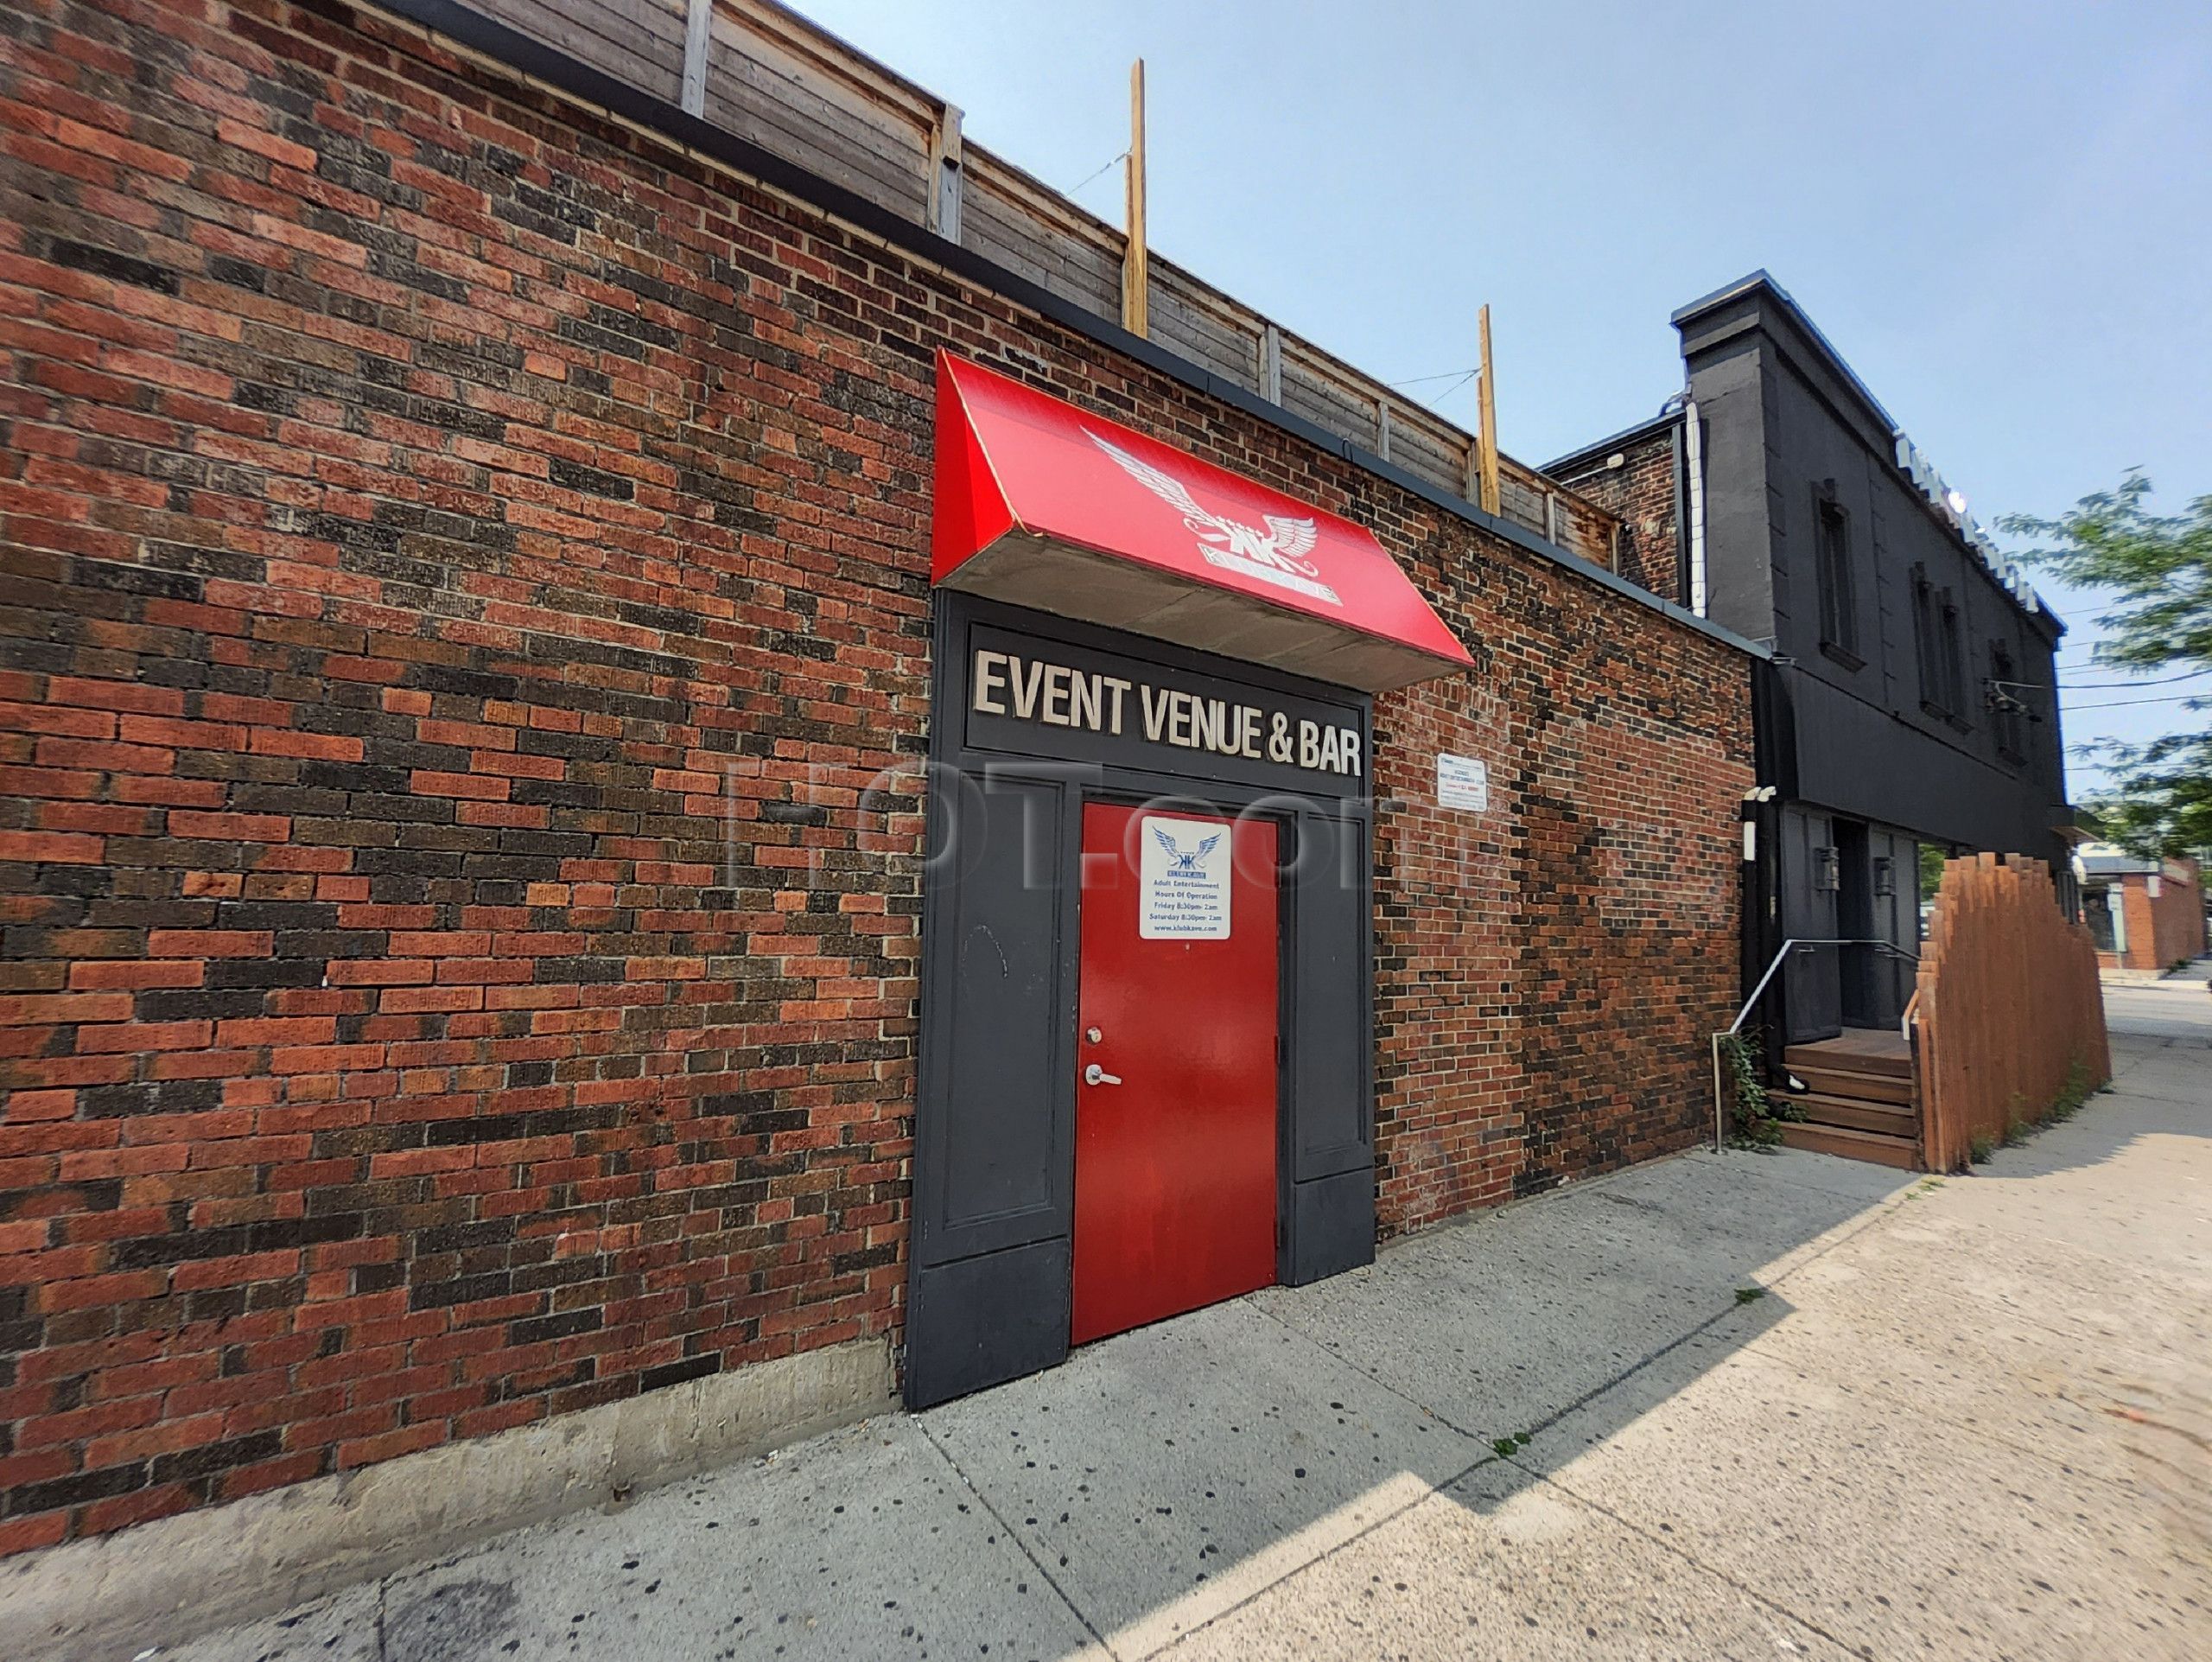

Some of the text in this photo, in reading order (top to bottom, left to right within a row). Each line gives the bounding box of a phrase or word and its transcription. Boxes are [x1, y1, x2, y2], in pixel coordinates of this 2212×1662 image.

[973, 650, 1362, 776] EVENT VENUE & BAR
[1154, 901, 1175, 910] Friday
[1149, 913, 1179, 921] Saturday
